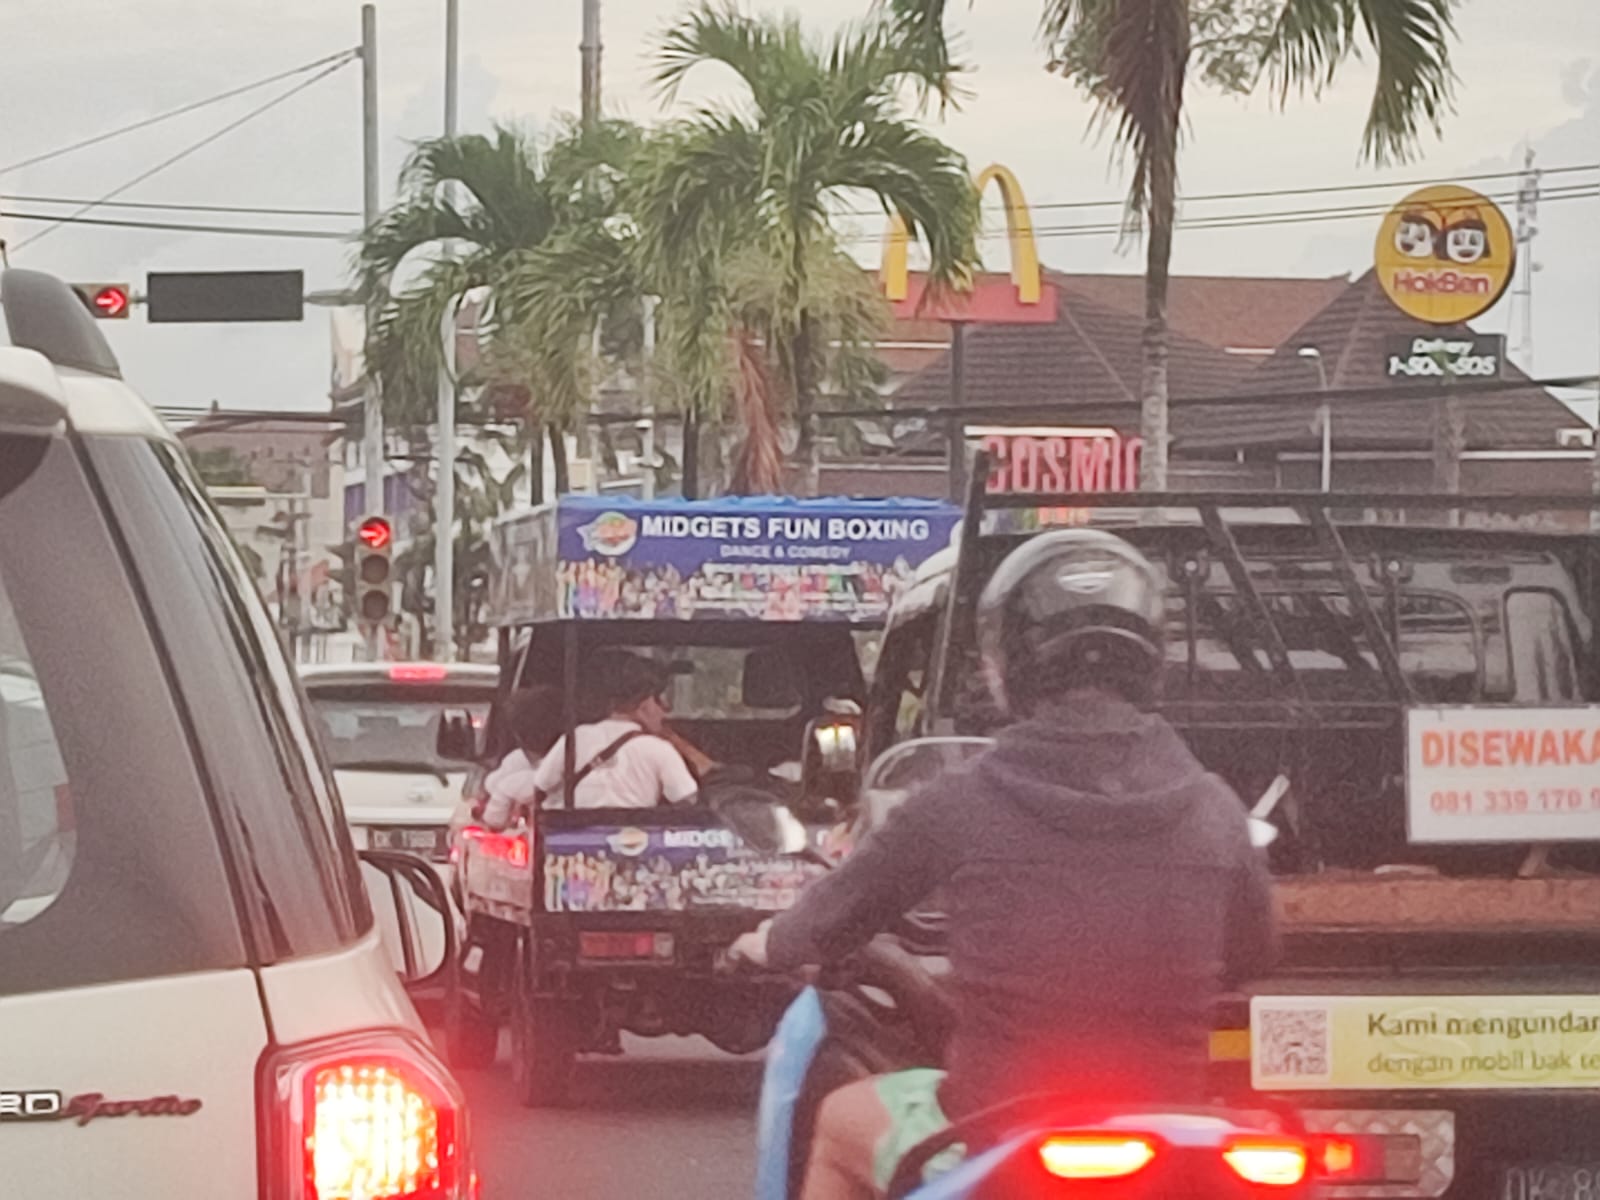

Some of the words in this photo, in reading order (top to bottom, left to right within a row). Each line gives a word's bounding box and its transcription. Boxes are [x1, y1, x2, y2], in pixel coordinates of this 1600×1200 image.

[1393, 272, 1489, 294] HokBen
[641, 515, 761, 539] MIDGETS
[767, 517, 821, 540] FUN
[827, 518, 929, 541] BOXING
[1367, 1013, 1438, 1037] Kami
[1367, 1052, 1453, 1076] dengan
[1461, 1050, 1524, 1072] mobil
[1531, 1050, 1572, 1071] bak
